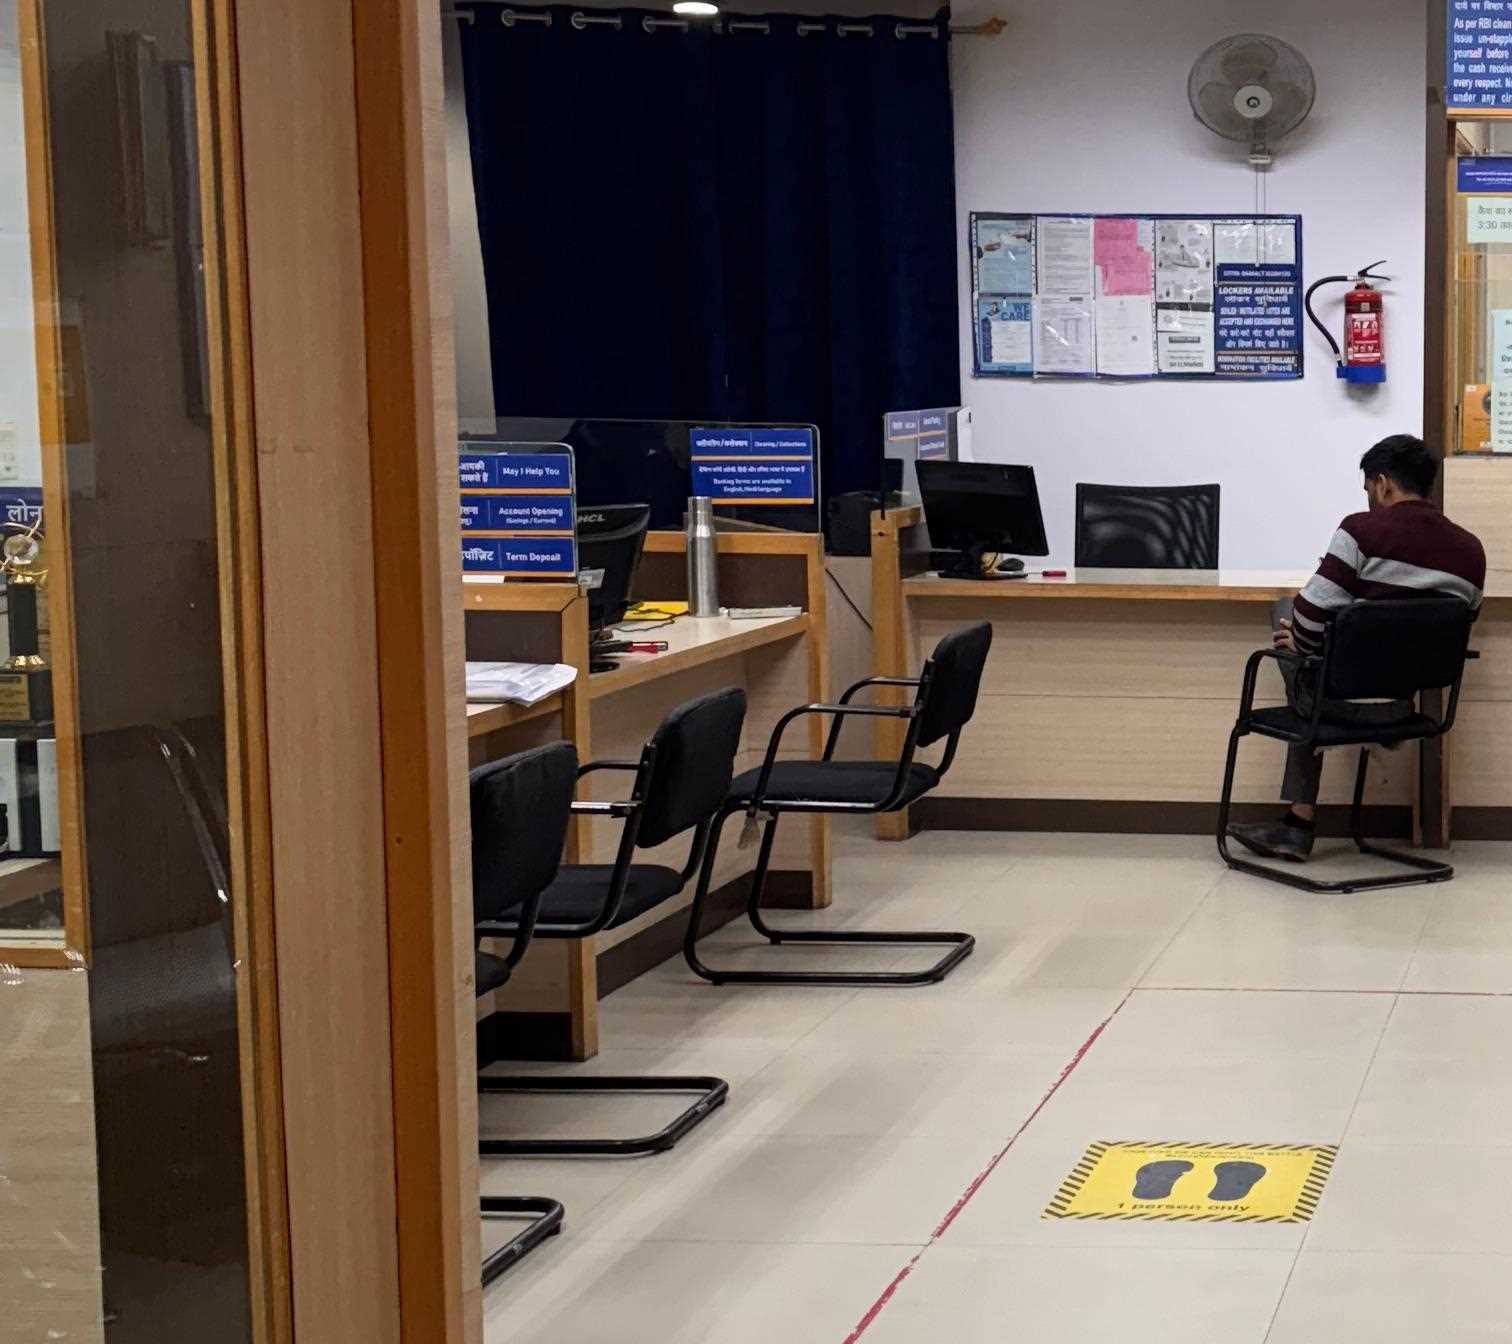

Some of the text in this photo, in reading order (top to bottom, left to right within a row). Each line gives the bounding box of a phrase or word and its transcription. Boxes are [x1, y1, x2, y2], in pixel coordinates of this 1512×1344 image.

[1454, 18, 1464, 29] As
[1465, 20, 1477, 31] per
[1478, 18, 1491, 29] RBI
[1493, 18, 1512, 29] clean
[1454, 47, 1483, 60] yourself
[1487, 48, 1509, 59] before
[1454, 63, 1465, 73] the
[1469, 63, 1485, 73] cash
[1454, 79, 1473, 90] every
[1453, 93, 1476, 104] under
[1481, 95, 1496, 105] any
[1478, 220, 1497, 231] 3:30
[1015, 303, 1030, 312] WE
[1001, 312, 1031, 321] CARE
[503, 467, 519, 476] May
[525, 467, 544, 476] Help
[545, 467, 560, 475] You
[499, 507, 563, 516] Account Opening
[506, 552, 561, 562] Term Deposit
[1131, 1203, 1201, 1211] person
